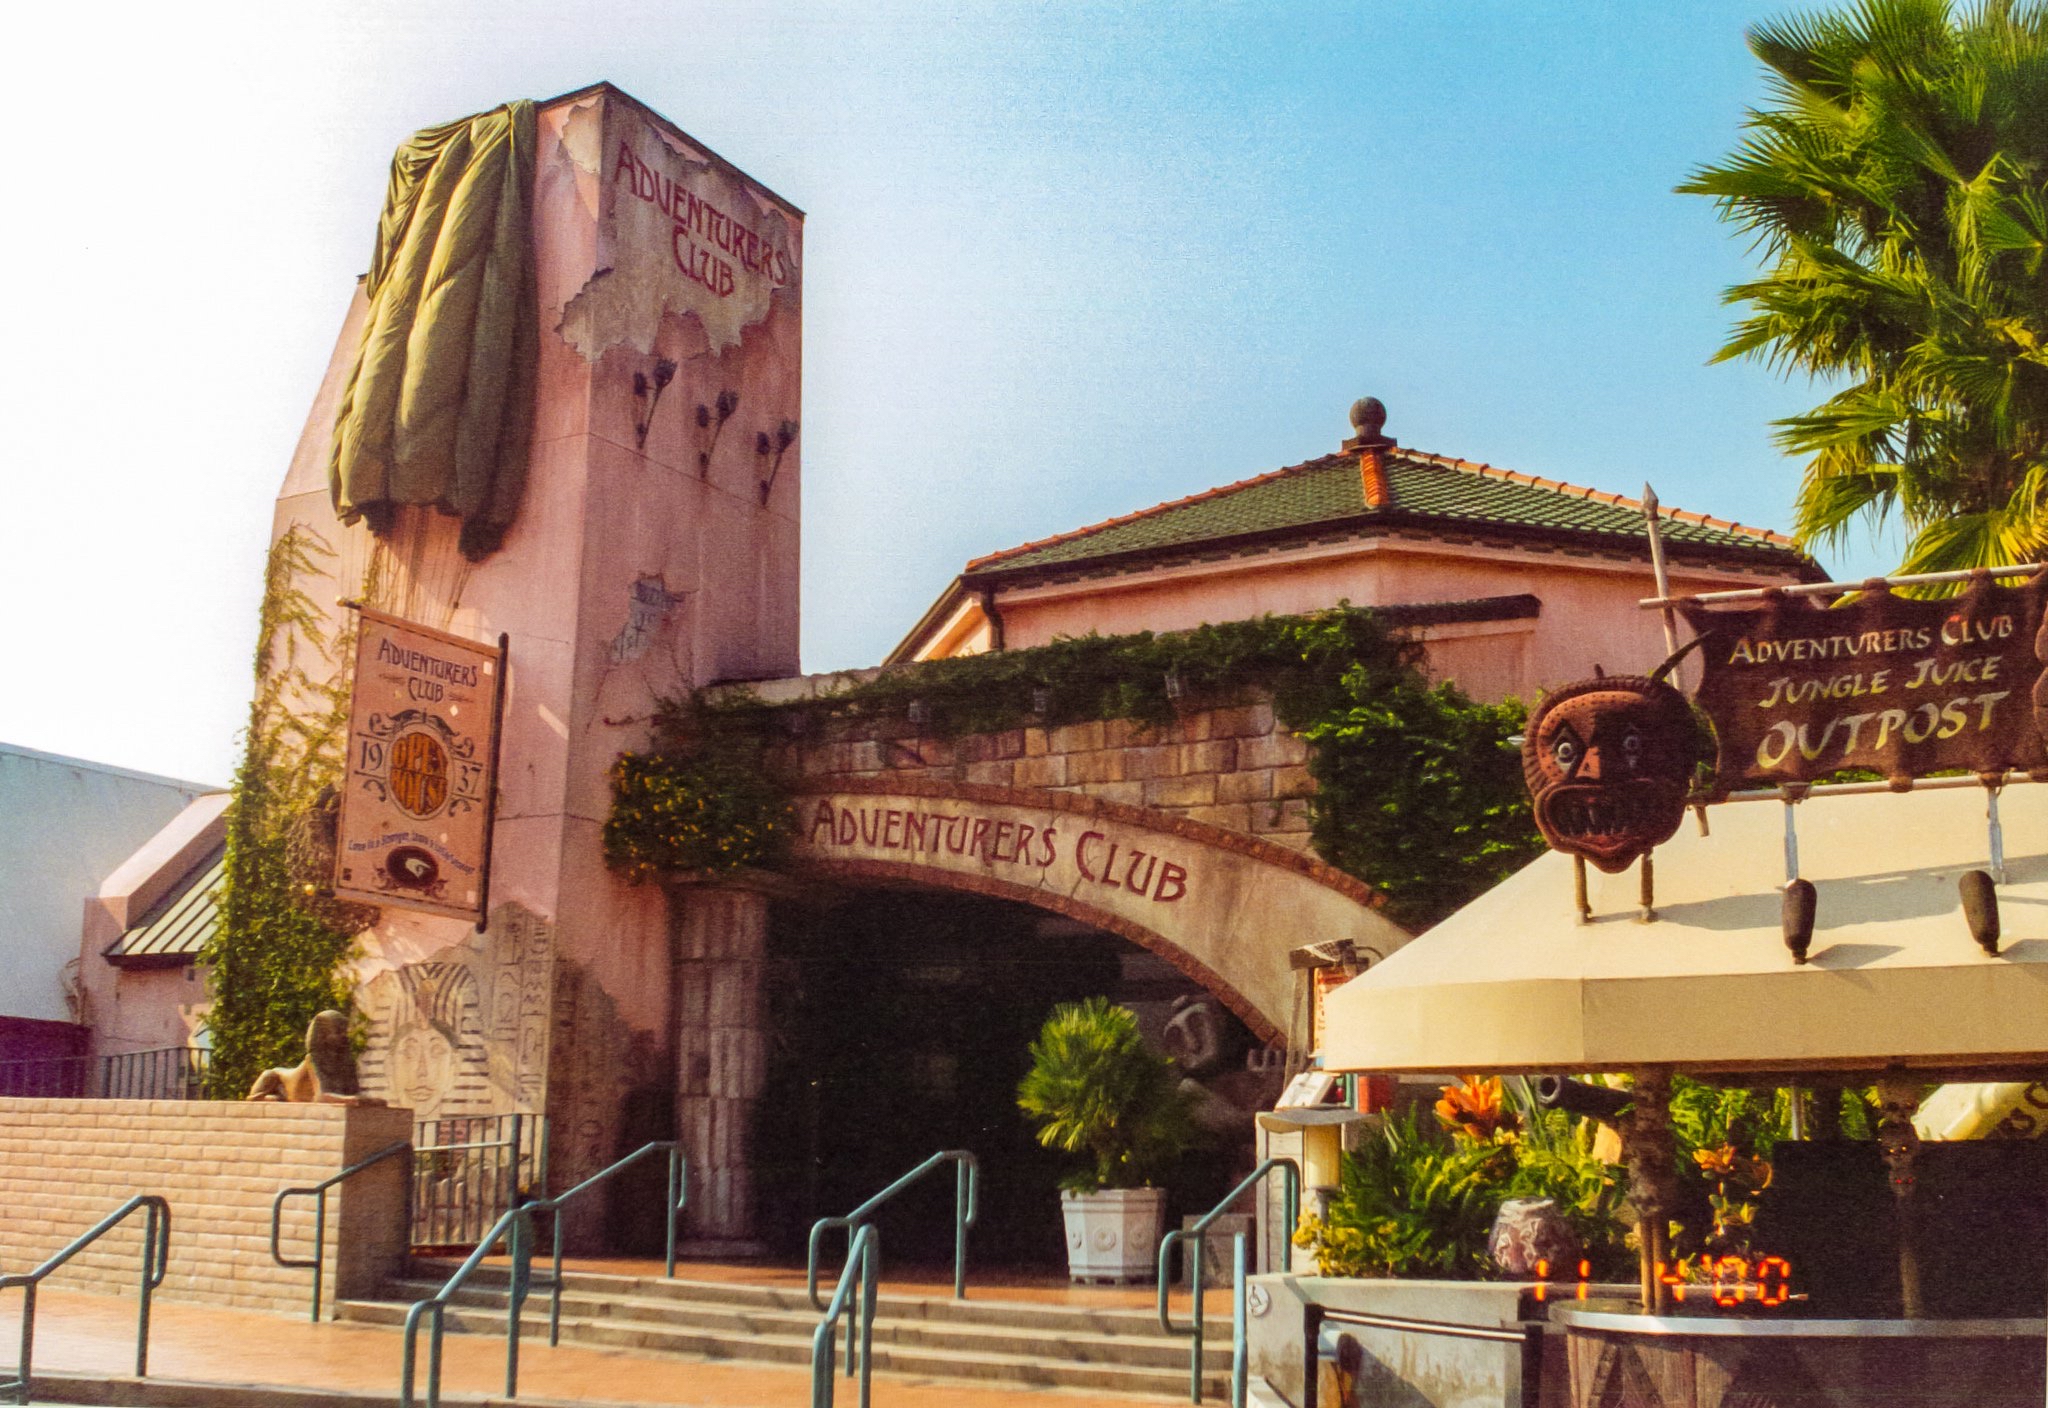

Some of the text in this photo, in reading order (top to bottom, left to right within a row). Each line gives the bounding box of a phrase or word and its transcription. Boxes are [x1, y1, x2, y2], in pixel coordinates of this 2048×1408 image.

[614, 140, 787, 286] ADVENTURERS
[672, 224, 735, 298] CLUB
[377, 638, 478, 688] ADVENTURERS
[1728, 614, 2014, 665] ADVENTURERS CLUB
[408, 676, 444, 703] CLUB
[1758, 656, 2002, 708] JUNGLE JUICE
[361, 740, 384, 771] 19
[1756, 690, 2010, 769] OUTPOST
[810, 799, 1189, 903] ADVENTURERS CLUB
